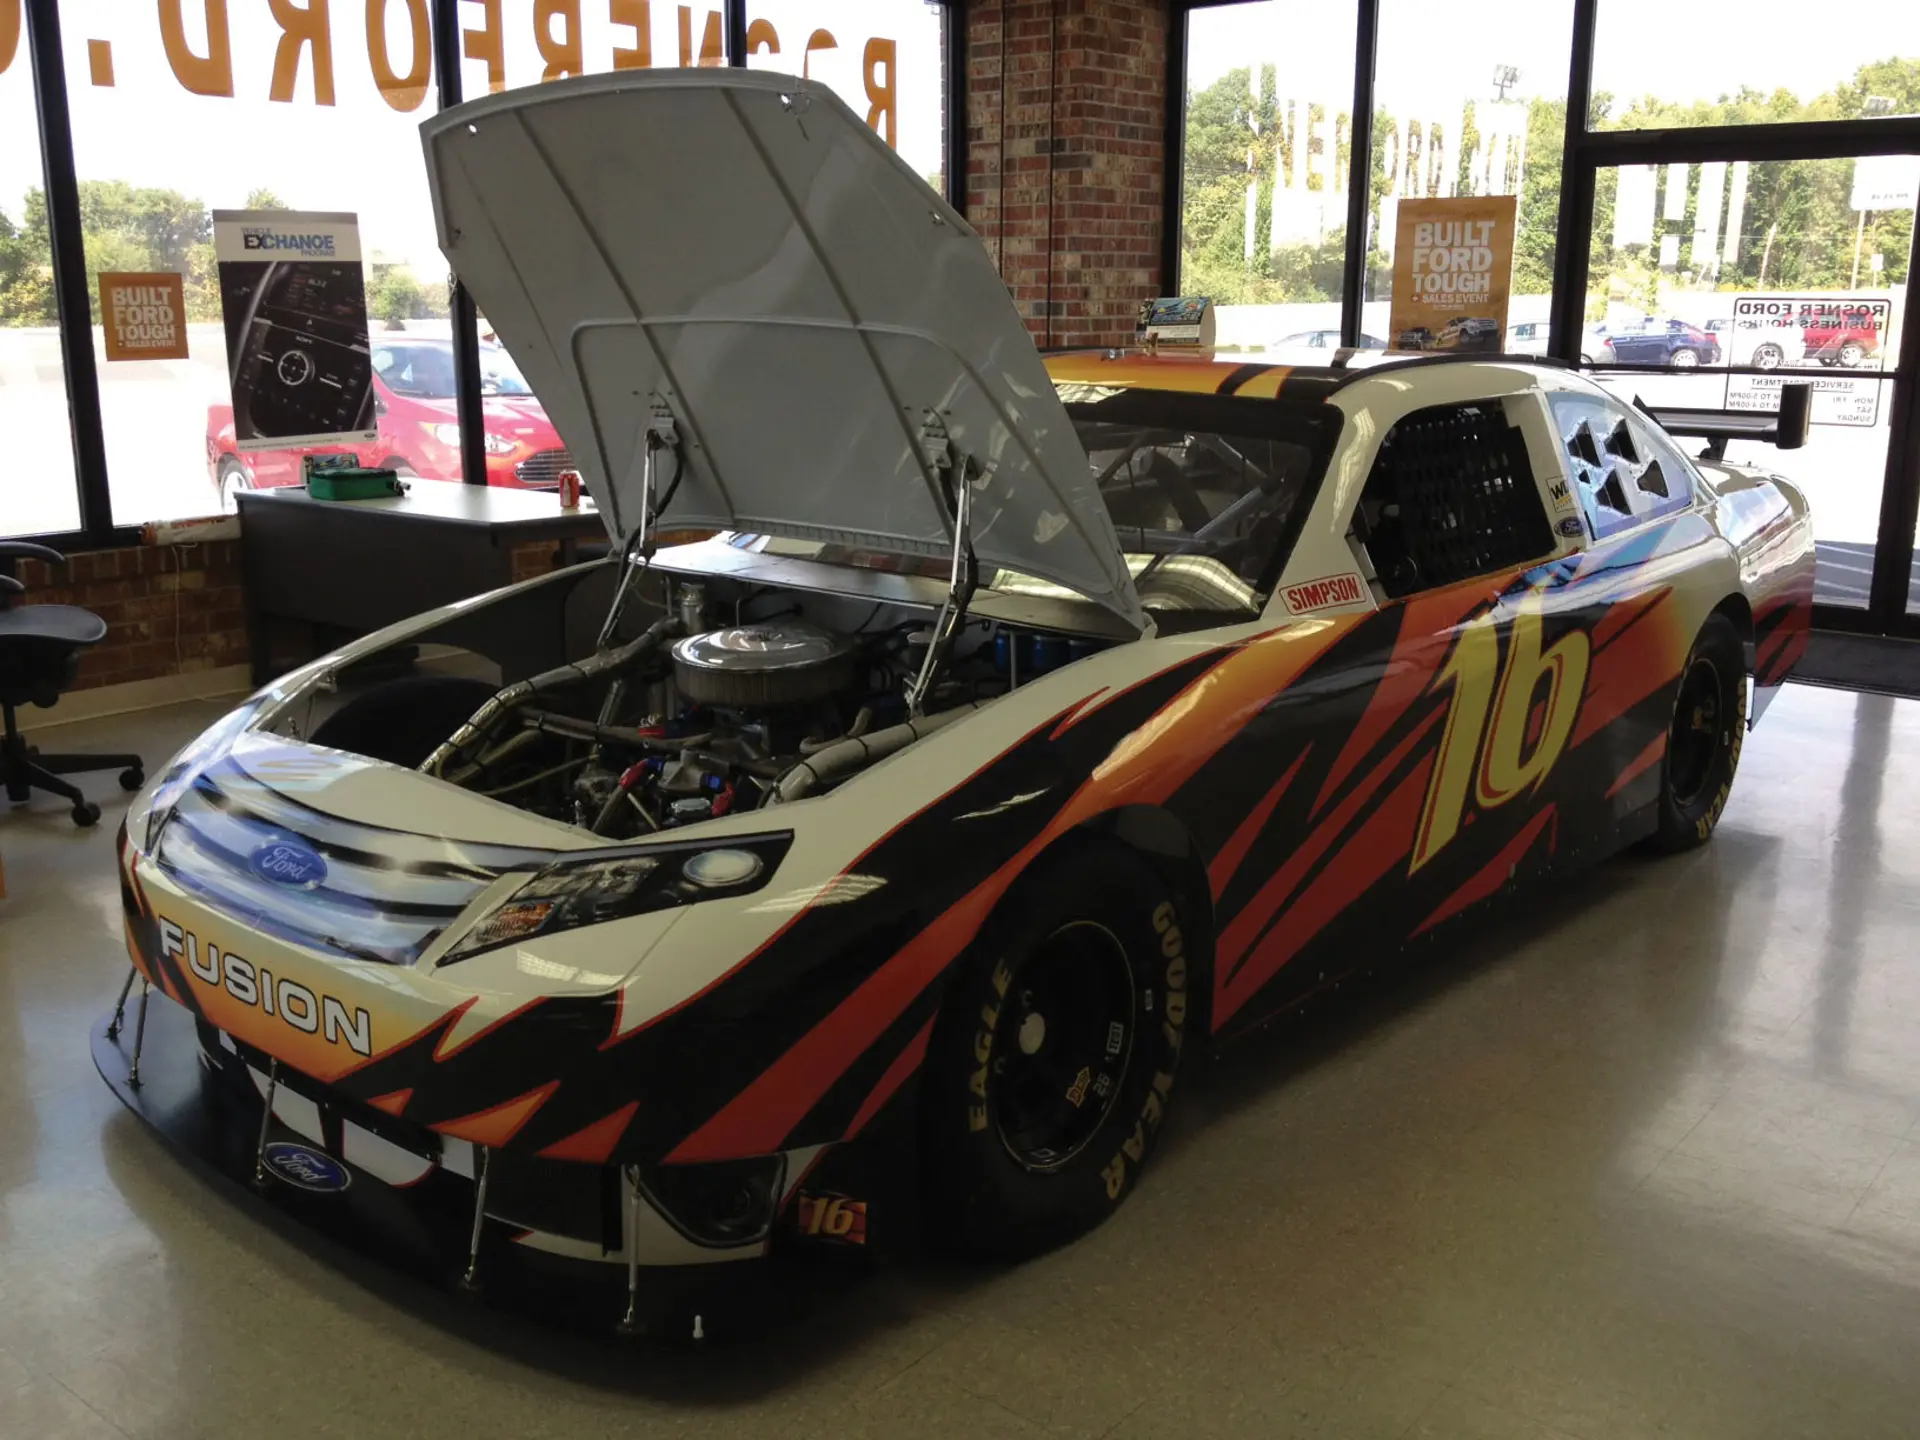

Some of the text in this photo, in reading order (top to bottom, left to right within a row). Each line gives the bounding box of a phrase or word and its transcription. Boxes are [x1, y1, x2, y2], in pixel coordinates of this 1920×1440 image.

[1414, 220, 1496, 247] BUILT
[1412, 247, 1493, 273] FORD
[111, 286, 172, 306] BUILT
[1411, 272, 1492, 293] TOUGH
[1422, 293, 1489, 303] SALES EVENT
[113, 305, 174, 325] FORD
[115, 324, 176, 341] TOUGH
[1287, 576, 1360, 611] SIMPSON
[1408, 577, 1591, 877] 16
[262, 845, 312, 881] Ford
[158, 914, 373, 1058] FUSION
[272, 1152, 332, 1183] Ford
[807, 1197, 854, 1235] 16
